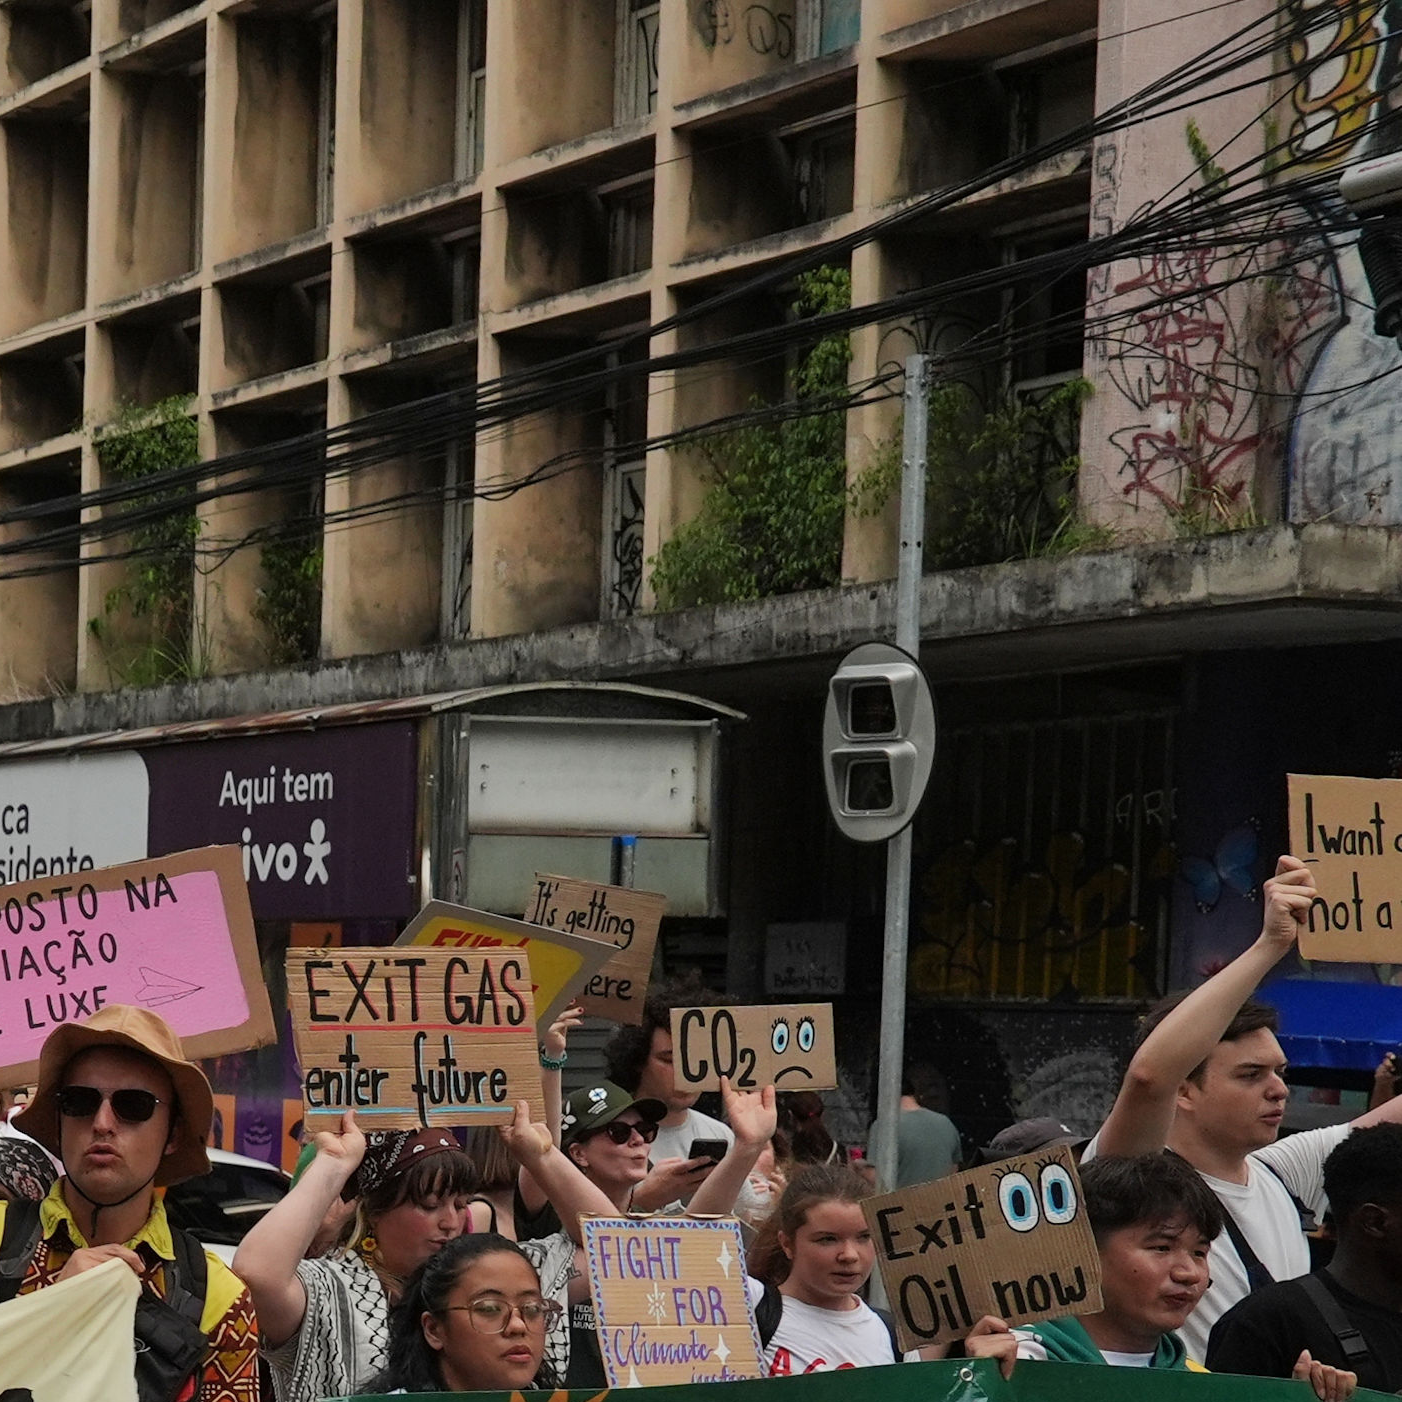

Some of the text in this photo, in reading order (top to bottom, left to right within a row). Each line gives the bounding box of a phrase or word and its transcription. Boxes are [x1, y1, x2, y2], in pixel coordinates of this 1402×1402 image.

[219, 765, 333, 815] Aqui tem
[1317, 801, 1385, 855] want
[124, 873, 178, 912] NA
[561, 890, 635, 949] getting
[1309, 872, 1392, 932] not a
[444, 957, 528, 1026] GAS
[583, 973, 633, 1001] ere
[303, 1031, 508, 1128] enter future
[876, 1183, 986, 1261] Exit
[599, 1235, 682, 1281] FIGHT
[672, 1286, 728, 1327] FOR
[899, 1264, 1087, 1339] Oil now
[614, 1322, 713, 1368] Climate
